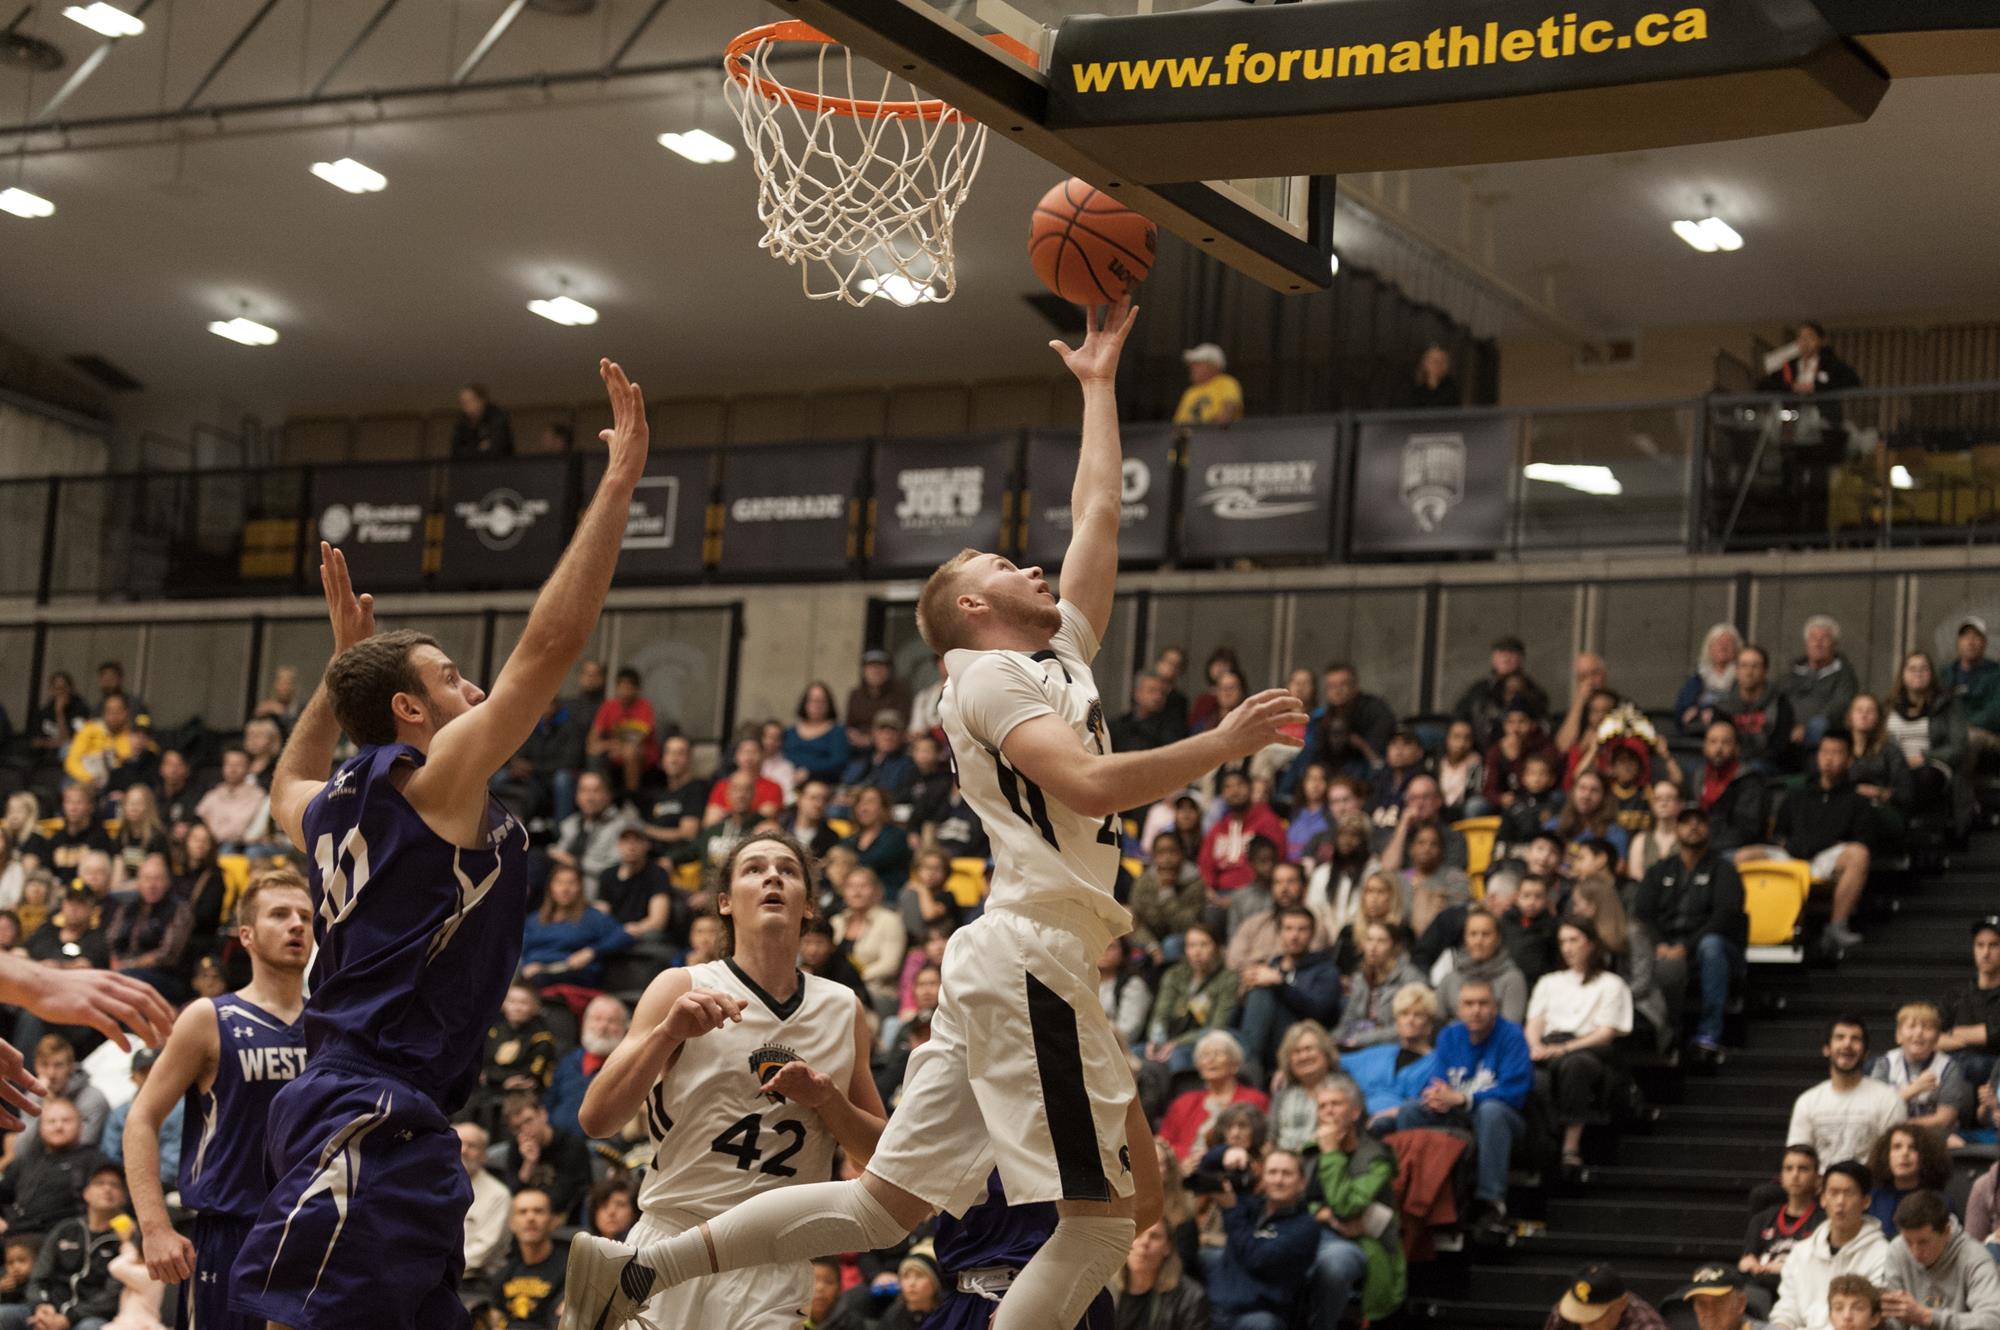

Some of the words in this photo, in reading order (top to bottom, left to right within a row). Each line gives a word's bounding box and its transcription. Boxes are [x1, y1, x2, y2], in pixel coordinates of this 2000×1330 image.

[1072, 7, 1708, 93] www.forumathletic.ca
[732, 494, 844, 522] GATORADE
[711, 1113, 807, 1177] 42
